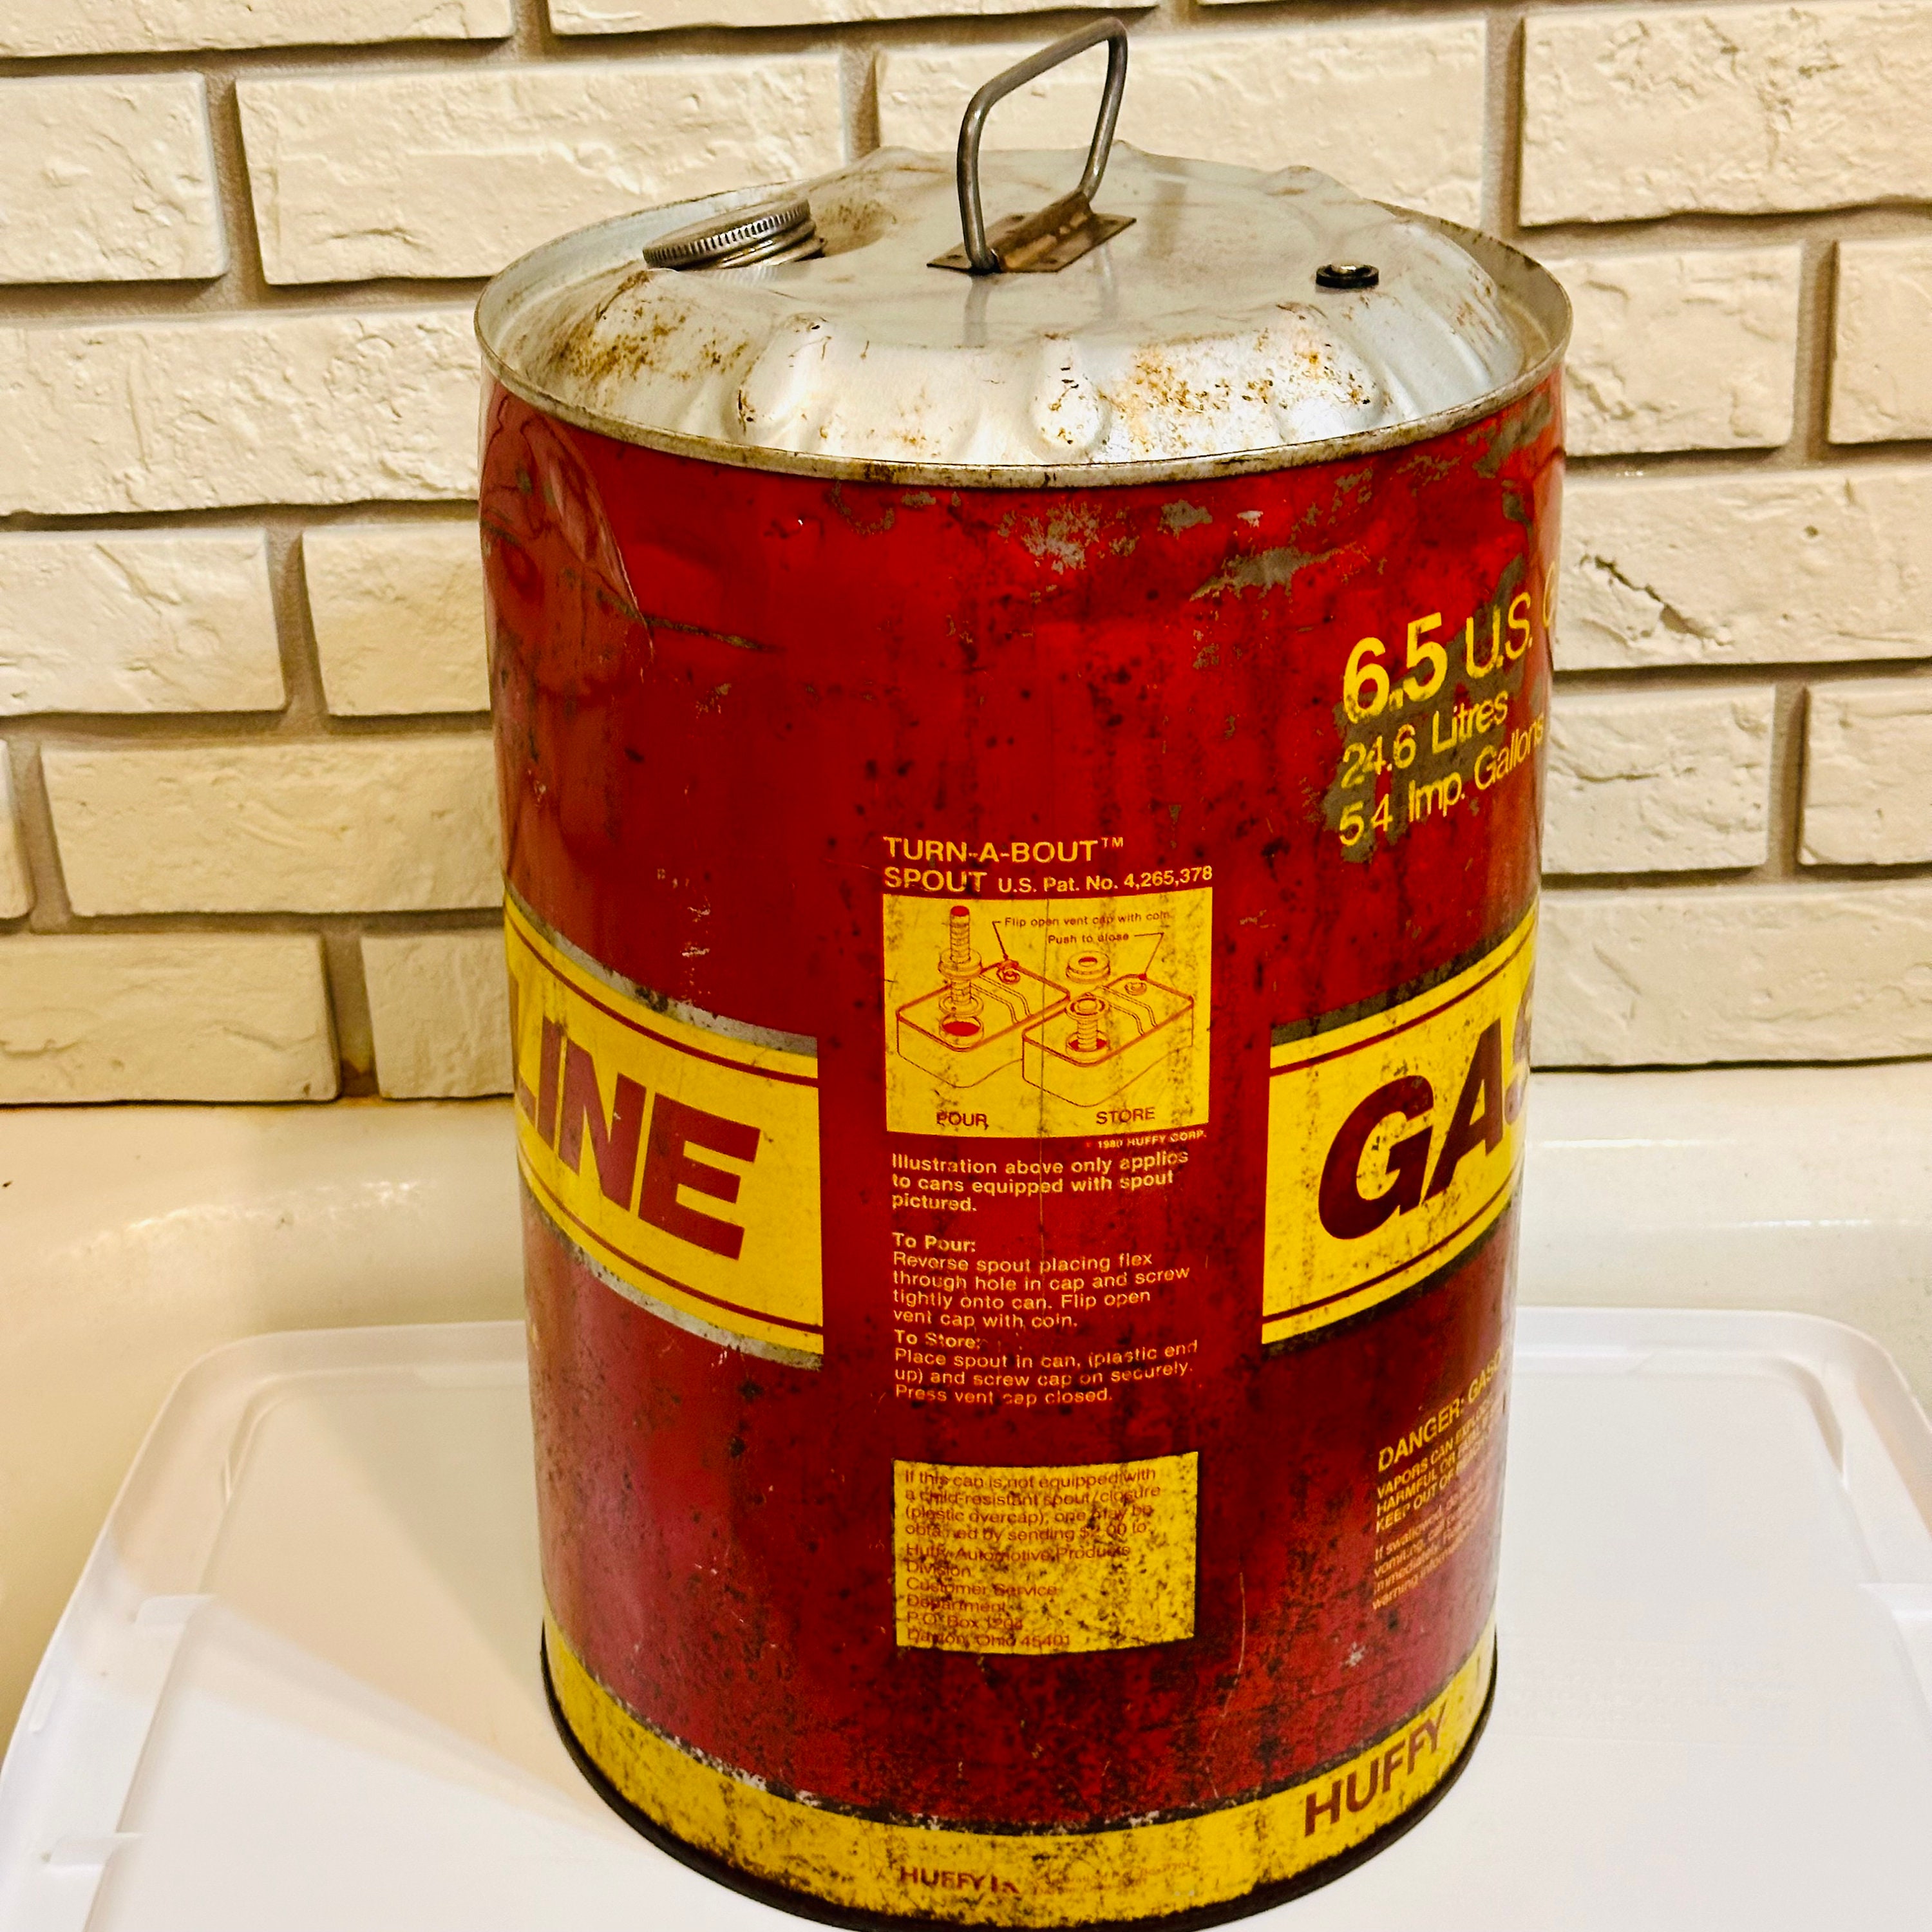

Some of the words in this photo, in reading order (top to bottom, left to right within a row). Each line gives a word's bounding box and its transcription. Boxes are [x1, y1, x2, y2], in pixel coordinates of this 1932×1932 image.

[1343, 612, 1448, 724] 6.5
[1466, 592, 1533, 678] U.S.
[1341, 724, 1416, 789] 24.6
[1432, 690, 1508, 754] Litres
[1340, 793, 1393, 846] 54
[1408, 772, 1465, 822] Imp.
[1474, 713, 1544, 790] Gallons
[885, 867, 987, 893] SPOUT
[999, 878, 1036, 893] U.S.
[1044, 876, 1079, 892] Pat.
[1086, 875, 1118, 890] No.
[1124, 866, 1213, 889] 4,265,378
[1005, 917, 1026, 927] Flip
[1031, 918, 1059, 928] open
[1064, 916, 1088, 925] vent
[1093, 915, 1113, 925] cap
[1118, 913, 1142, 923] with
[1048, 934, 1077, 944] Push
[1082, 933, 1093, 943] to
[936, 1112, 988, 1128] POUR
[1095, 1107, 1155, 1125] STORE
[1127, 1135, 1166, 1147] HUFFY
[1170, 1130, 1207, 1142] CORP.
[892, 1153, 997, 1175] Illustration
[1005, 1160, 1063, 1175] above
[1071, 1157, 1112, 1175] only
[1119, 1150, 1189, 1172] applies
[892, 1173, 911, 1189] to
[918, 1178, 964, 1193] cans
[972, 1179, 1063, 1198] equipped
[1071, 1175, 1112, 1192] with
[1120, 1170, 1173, 1191] spout
[892, 1193, 978, 1212] pictured.
[893, 1232, 917, 1249] To
[925, 1235, 976, 1253] Pour:
[893, 1252, 969, 1272] Reverse
[976, 1258, 1030, 1275] spout
[1040, 1256, 1110, 1276] placing
[1119, 1252, 1153, 1267] flex
[893, 1271, 967, 1293] through
[975, 1276, 1018, 1292] hole
[1025, 1275, 1041, 1291] in
[1050, 1277, 1085, 1294] cap
[1092, 1271, 1127, 1289] and
[1135, 1267, 1191, 1285] screw
[893, 1290, 953, 1310] tightly
[961, 1295, 1005, 1310] onto
[1012, 1296, 1052, 1310] can.
[1061, 1293, 1097, 1311] Flip
[1104, 1291, 1151, 1307] open
[893, 1309, 933, 1324] vent
[940, 1314, 975, 1329] cap
[982, 1313, 1024, 1329] with
[1031, 1314, 1078, 1329] coin.
[894, 1329, 918, 1346] To
[925, 1332, 981, 1349] Store:
[895, 1349, 947, 1366] Place
[954, 1354, 1008, 1371] spout
[1016, 1353, 1033, 1368] in
[1164, 1340, 1198, 1358] end
[895, 1367, 924, 1385] up)
[931, 1370, 965, 1386] and
[972, 1374, 1030, 1387] screw
[1037, 1374, 1072, 1390] cap
[1080, 1371, 1103, 1385] on
[1111, 1361, 1193, 1383] securely.
[896, 1385, 947, 1403] Press
[954, 1390, 994, 1405] vent
[1003, 1392, 1037, 1408] cap
[1045, 1387, 1113, 1405] closed.
[920, 1471, 949, 1486] this
[1007, 1476, 1035, 1489] not
[1039, 1471, 1118, 1492] equipped
[1124, 1468, 1157, 1482] with
[1377, 1468, 1437, 1517] HARMFUL
[1054, 1512, 1086, 1523] one
[1376, 1502, 1410, 1534] KEEP
[905, 1522, 978, 1539] obtaed
[983, 1528, 1003, 1542] by
[1008, 1527, 1075, 1542] sending
[1133, 1520, 1146, 1534] to
[954, 1548, 1050, 1562] Automotive
[907, 1560, 971, 1577] Division
[907, 1577, 986, 1596] Customer
[993, 1583, 1057, 1597] Service
[907, 1594, 1006, 1612] Department
[947, 1615, 979, 1629] Box
[976, 1633, 1016, 1647] Ohio
[1021, 1634, 1070, 1647] 45401
[1305, 1698, 1448, 1837] HUFFY
[900, 1865, 987, 1891] HUFFY
